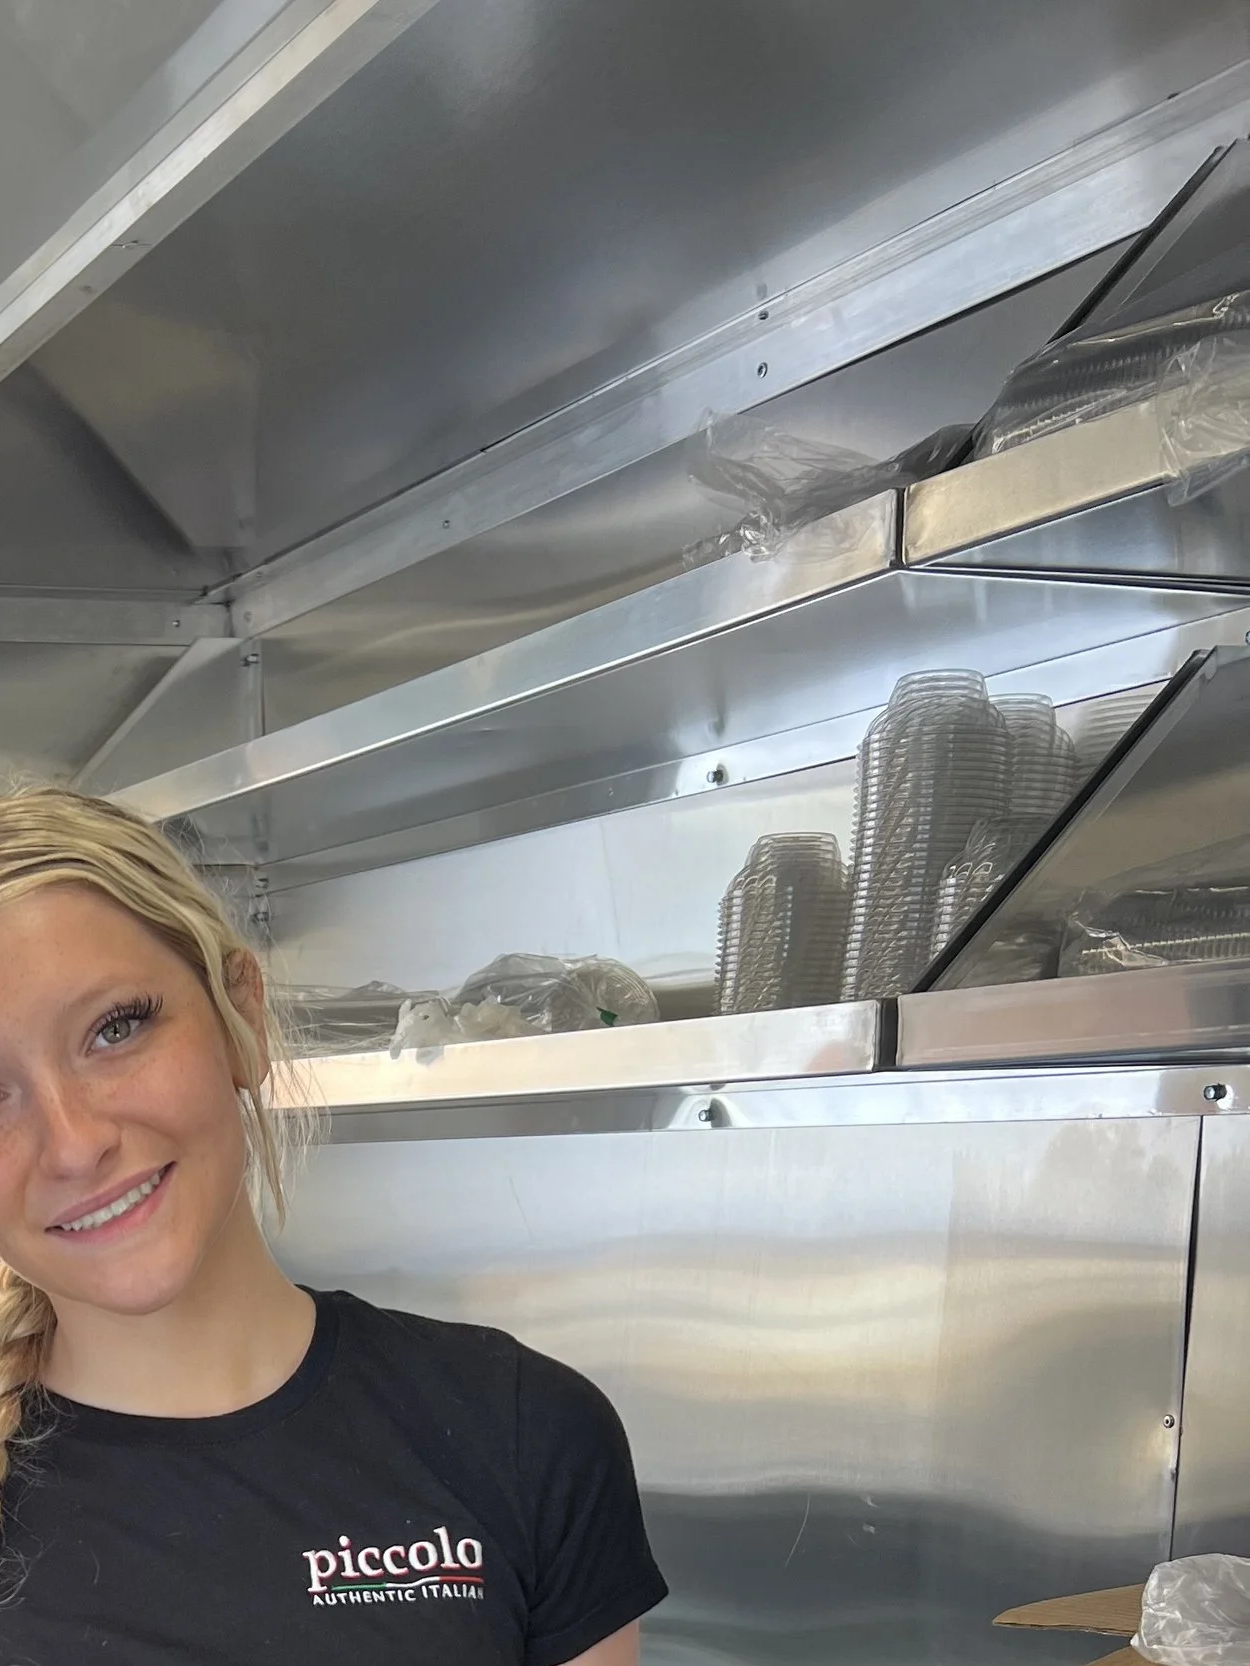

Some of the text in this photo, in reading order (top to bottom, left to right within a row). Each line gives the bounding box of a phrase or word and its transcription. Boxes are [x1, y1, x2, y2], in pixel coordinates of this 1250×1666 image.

[302, 1526, 484, 1593] piccolo
[312, 1584, 484, 1606] AUTHENTIC ITALIAN
